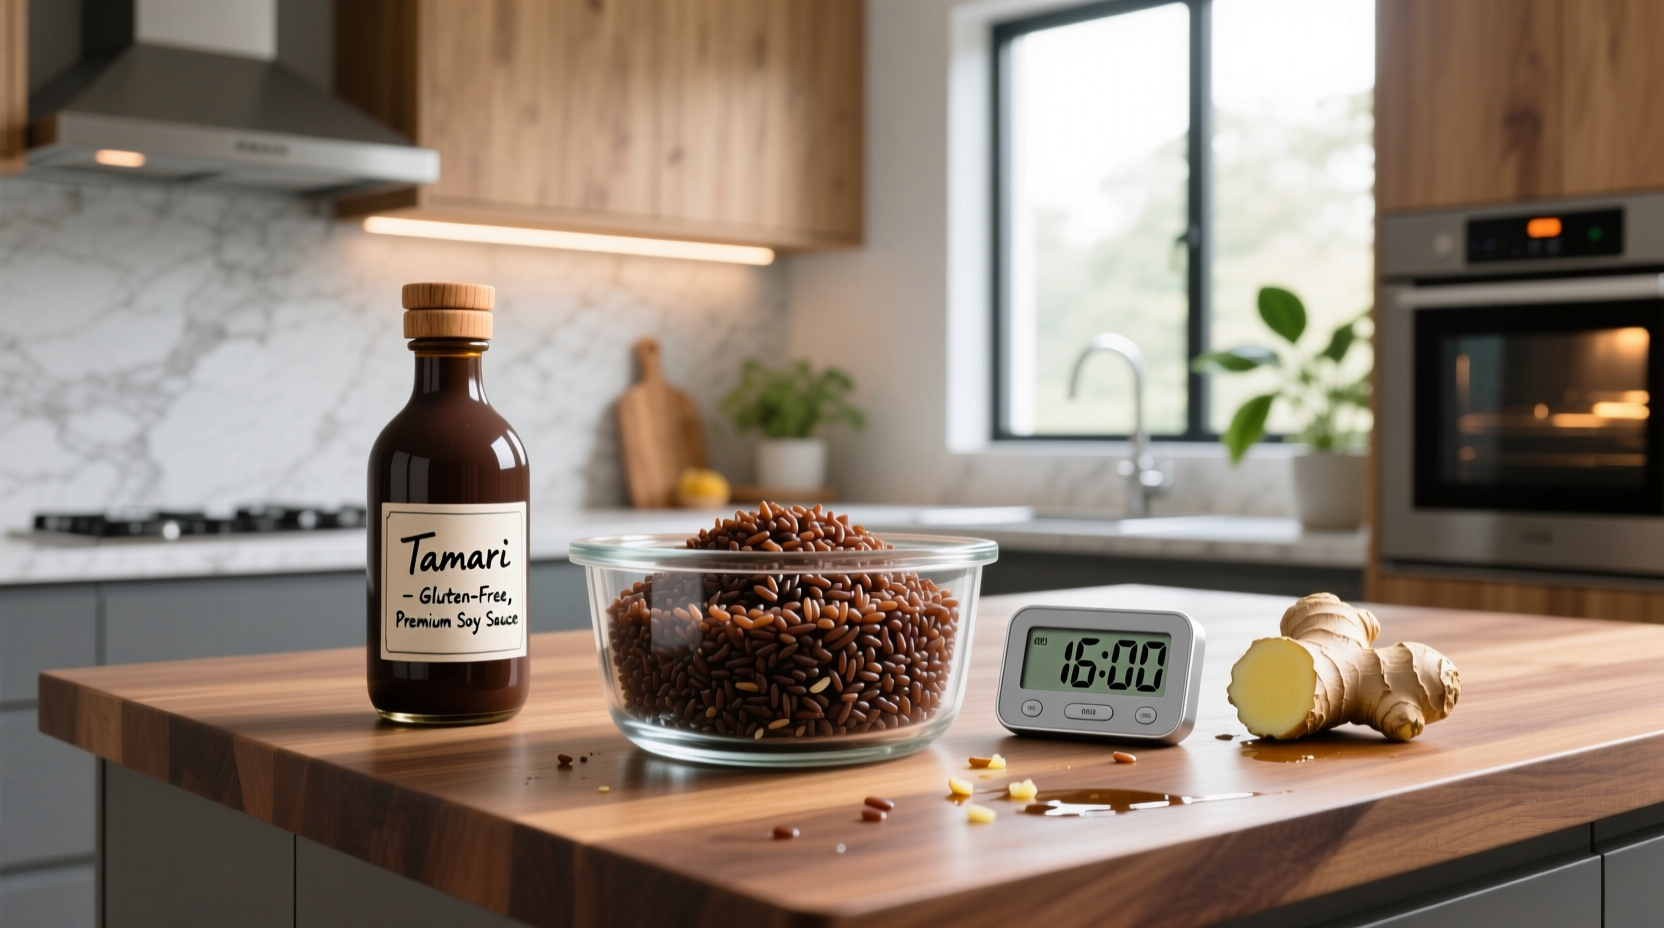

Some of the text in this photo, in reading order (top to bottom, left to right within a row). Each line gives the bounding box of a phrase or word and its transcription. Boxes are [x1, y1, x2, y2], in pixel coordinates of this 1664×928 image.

[400, 531, 511, 576] Tamari
[419, 585, 512, 606] Gluten-Free,
[396, 610, 519, 635] Premium Soy Sauce
[1060, 637, 1167, 692] 16:00
